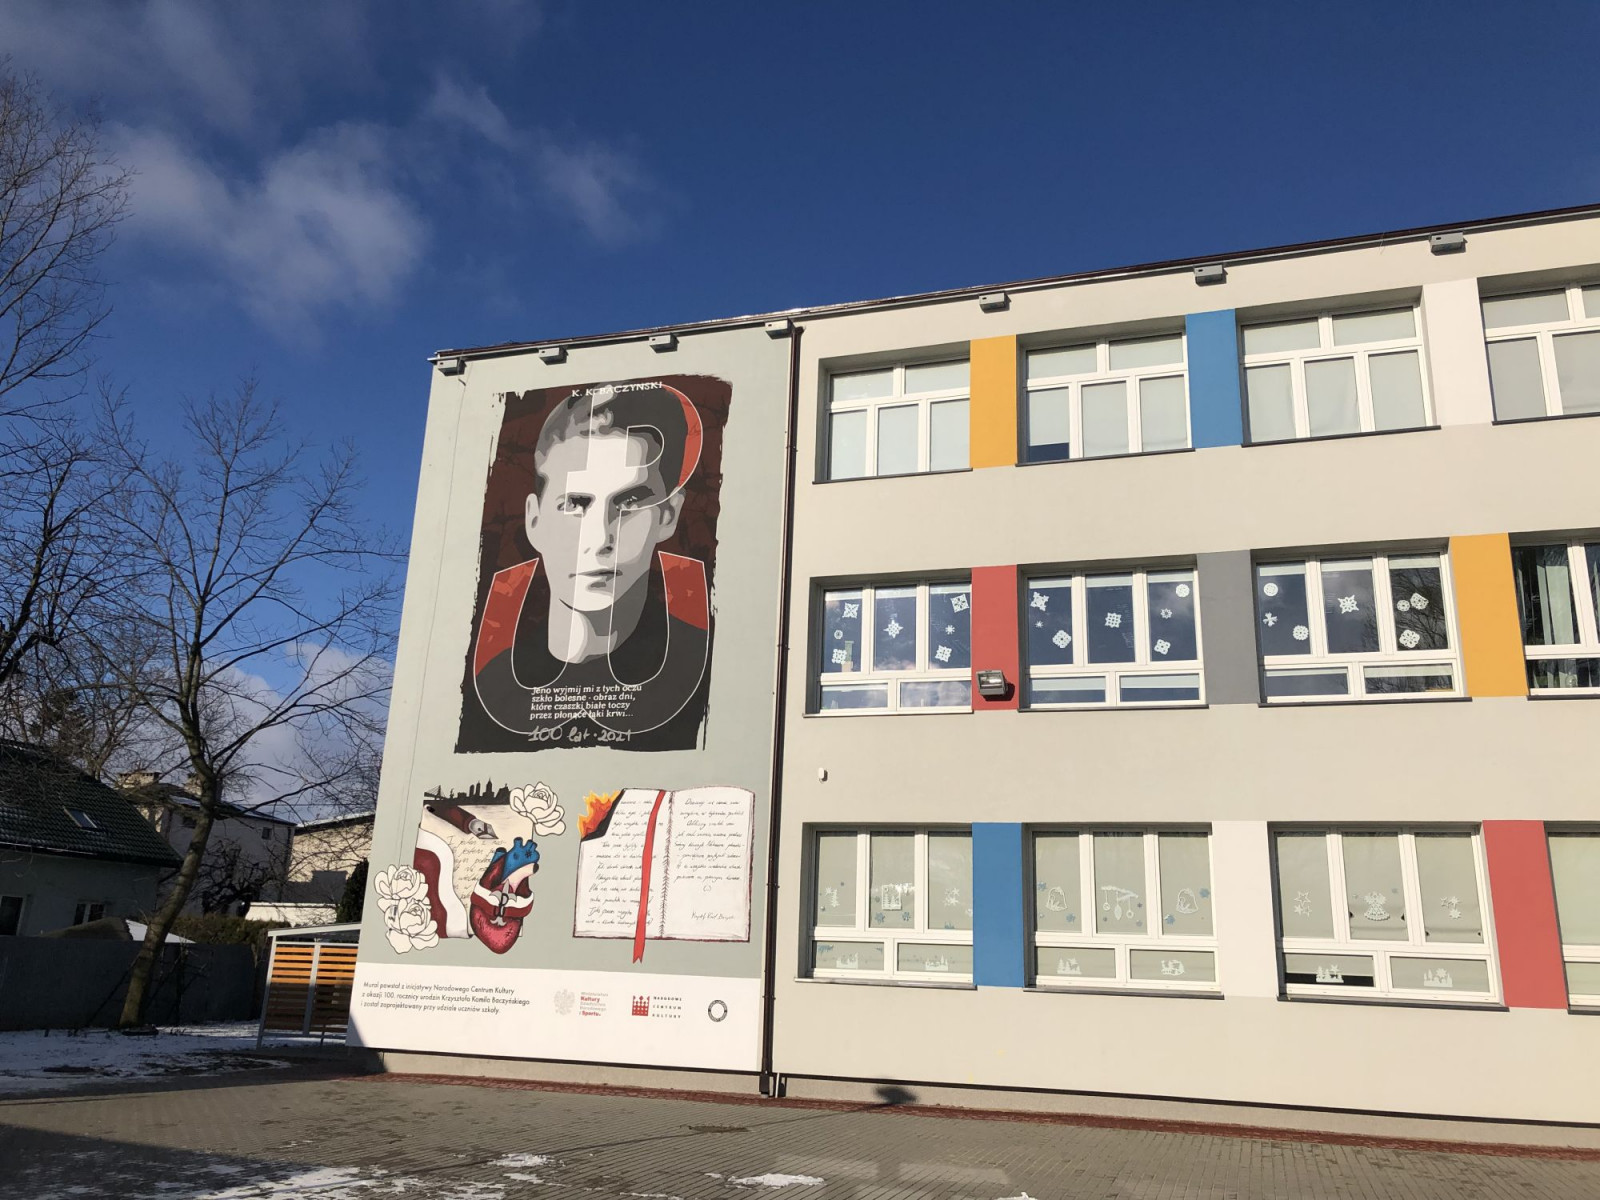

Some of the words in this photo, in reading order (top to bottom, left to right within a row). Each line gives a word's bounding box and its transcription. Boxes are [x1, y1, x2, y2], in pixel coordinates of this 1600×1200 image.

[571, 389, 583, 398] K.
[531, 686, 552, 695] Jeno
[553, 686, 581, 696] wyjmij
[583, 685, 595, 693] mi
[602, 684, 620, 693] tych
[531, 695, 553, 703] szkło
[554, 694, 587, 702] bolesne
[593, 693, 617, 701] obraz
[618, 691, 636, 701] dni,
[530, 702, 553, 711] które
[554, 701, 584, 710] czaszki
[585, 701, 607, 709] białe
[608, 701, 631, 709] toczy
[529, 711, 553, 720] przez
[554, 709, 587, 720] płonące
[588, 708, 605, 719] łąki
[527, 725, 563, 742] 100
[567, 726, 590, 742] lat
[598, 729, 631, 742] 2021
[406, 984, 432, 992] inicjatywy
[433, 984, 469, 993] Narodowego
[470, 985, 494, 993] Centrum
[494, 987, 515, 996] Kultury
[366, 990, 383, 999] okazji
[396, 993, 418, 1001] rocznicy
[441, 994, 471, 1003] Krzysztofa
[491, 996, 530, 1006] Baczyńskiego
[380, 1002, 422, 1011] zaprojektowany
[423, 1004, 436, 1012] przy
[436, 1004, 457, 1012] udziale
[457, 1005, 481, 1013] uczniów
